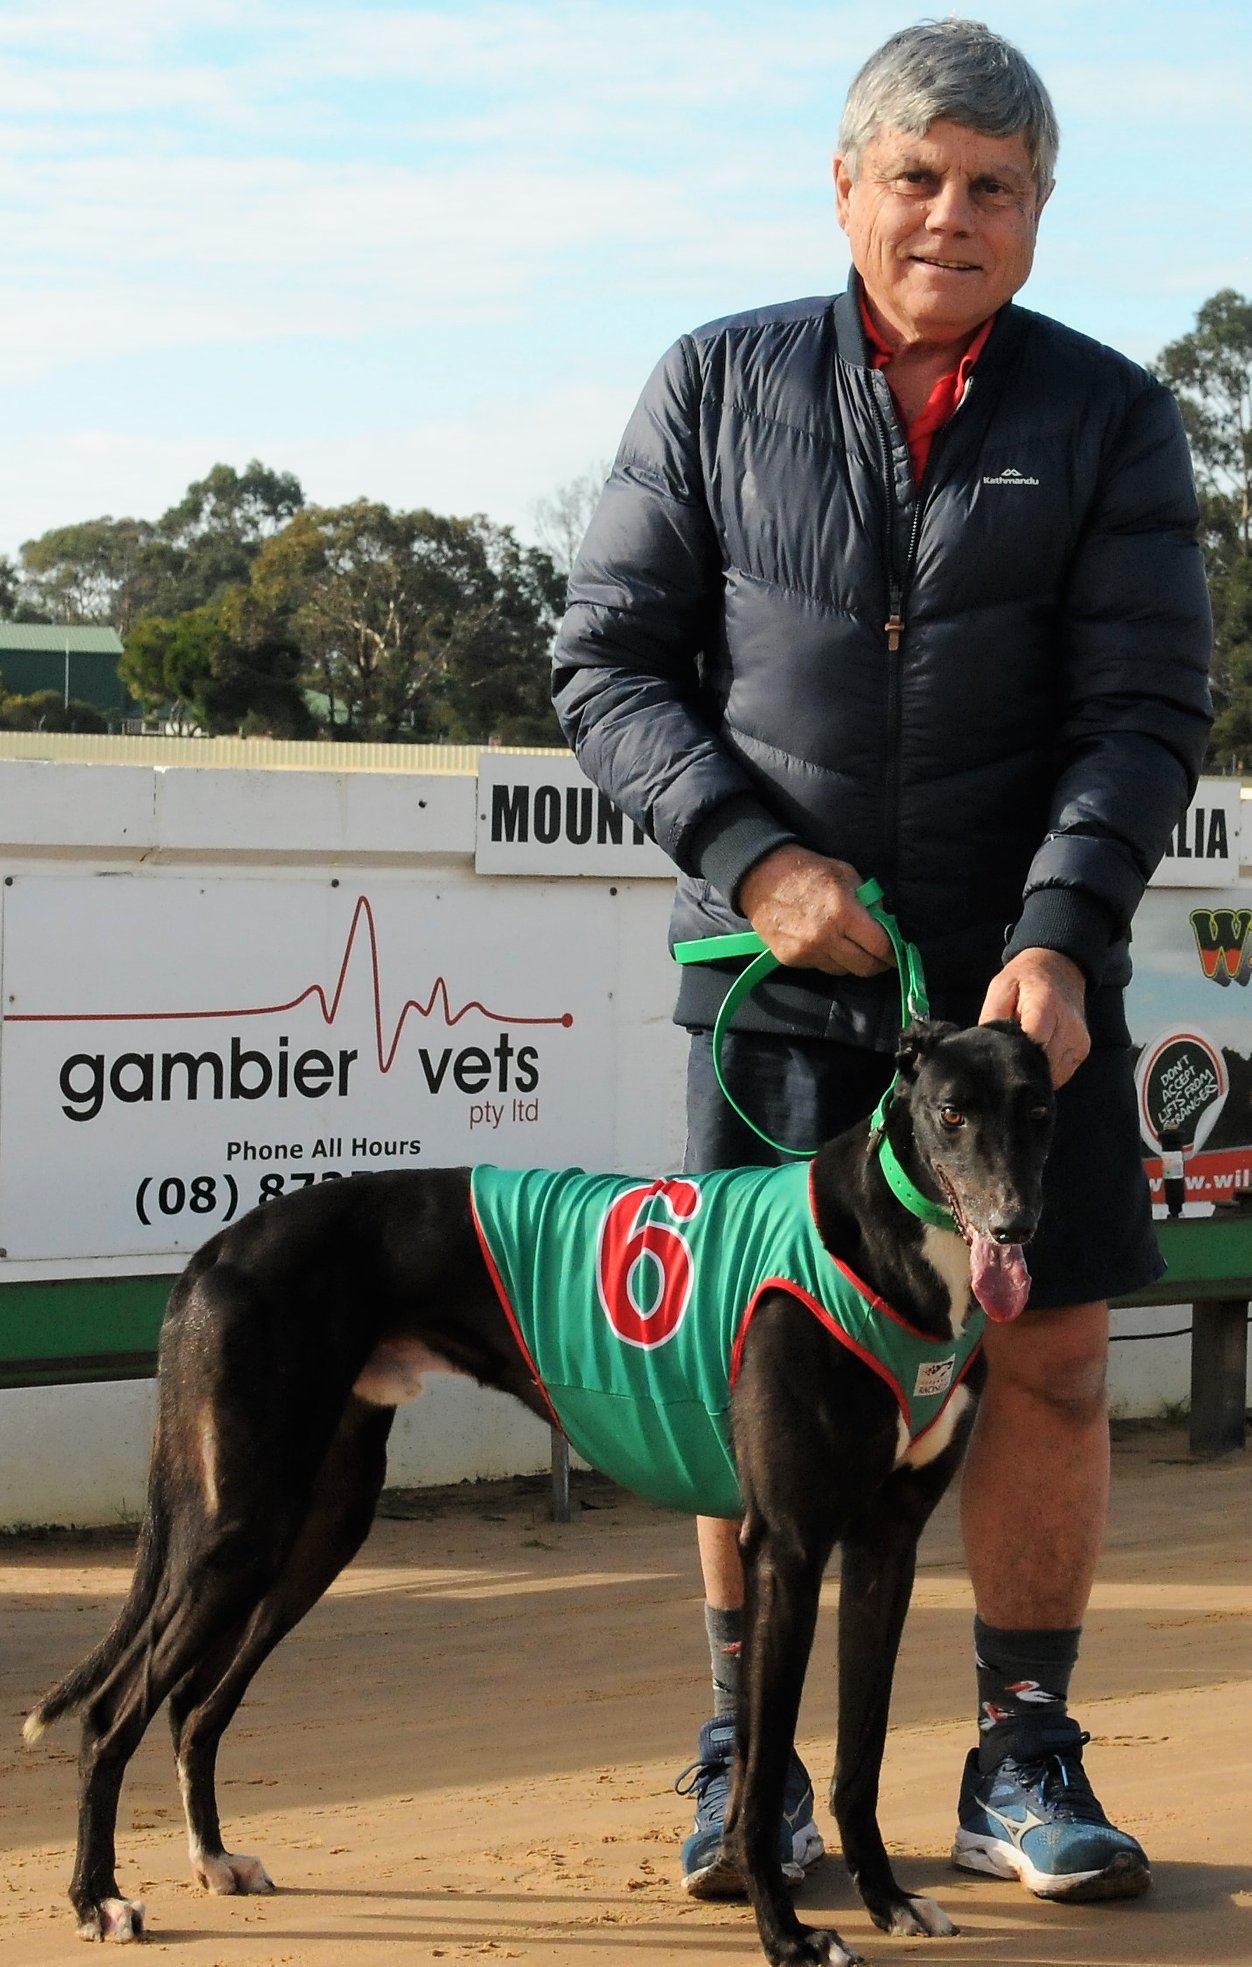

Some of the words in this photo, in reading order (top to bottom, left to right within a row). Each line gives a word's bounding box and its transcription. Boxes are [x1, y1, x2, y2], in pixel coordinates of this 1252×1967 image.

[983, 476, 1039, 485] Kathmandu
[1165, 808, 1228, 858] LIA
[1189, 908, 1252, 979] W
[58, 1036, 358, 1122] gambier
[418, 1032, 540, 1095] vets
[1158, 1090, 1186, 1124] LIFTS
[1184, 1069, 1215, 1099] FROM
[1162, 1065, 1196, 1103] ACCEPT
[469, 1100, 503, 1129] pty
[511, 1098, 539, 1122] ltd
[226, 1141, 303, 1161] Phone
[311, 1138, 342, 1159] All
[351, 1138, 421, 1157] Hours
[135, 1173, 239, 1226] (08)
[596, 1176, 702, 1351] 6
